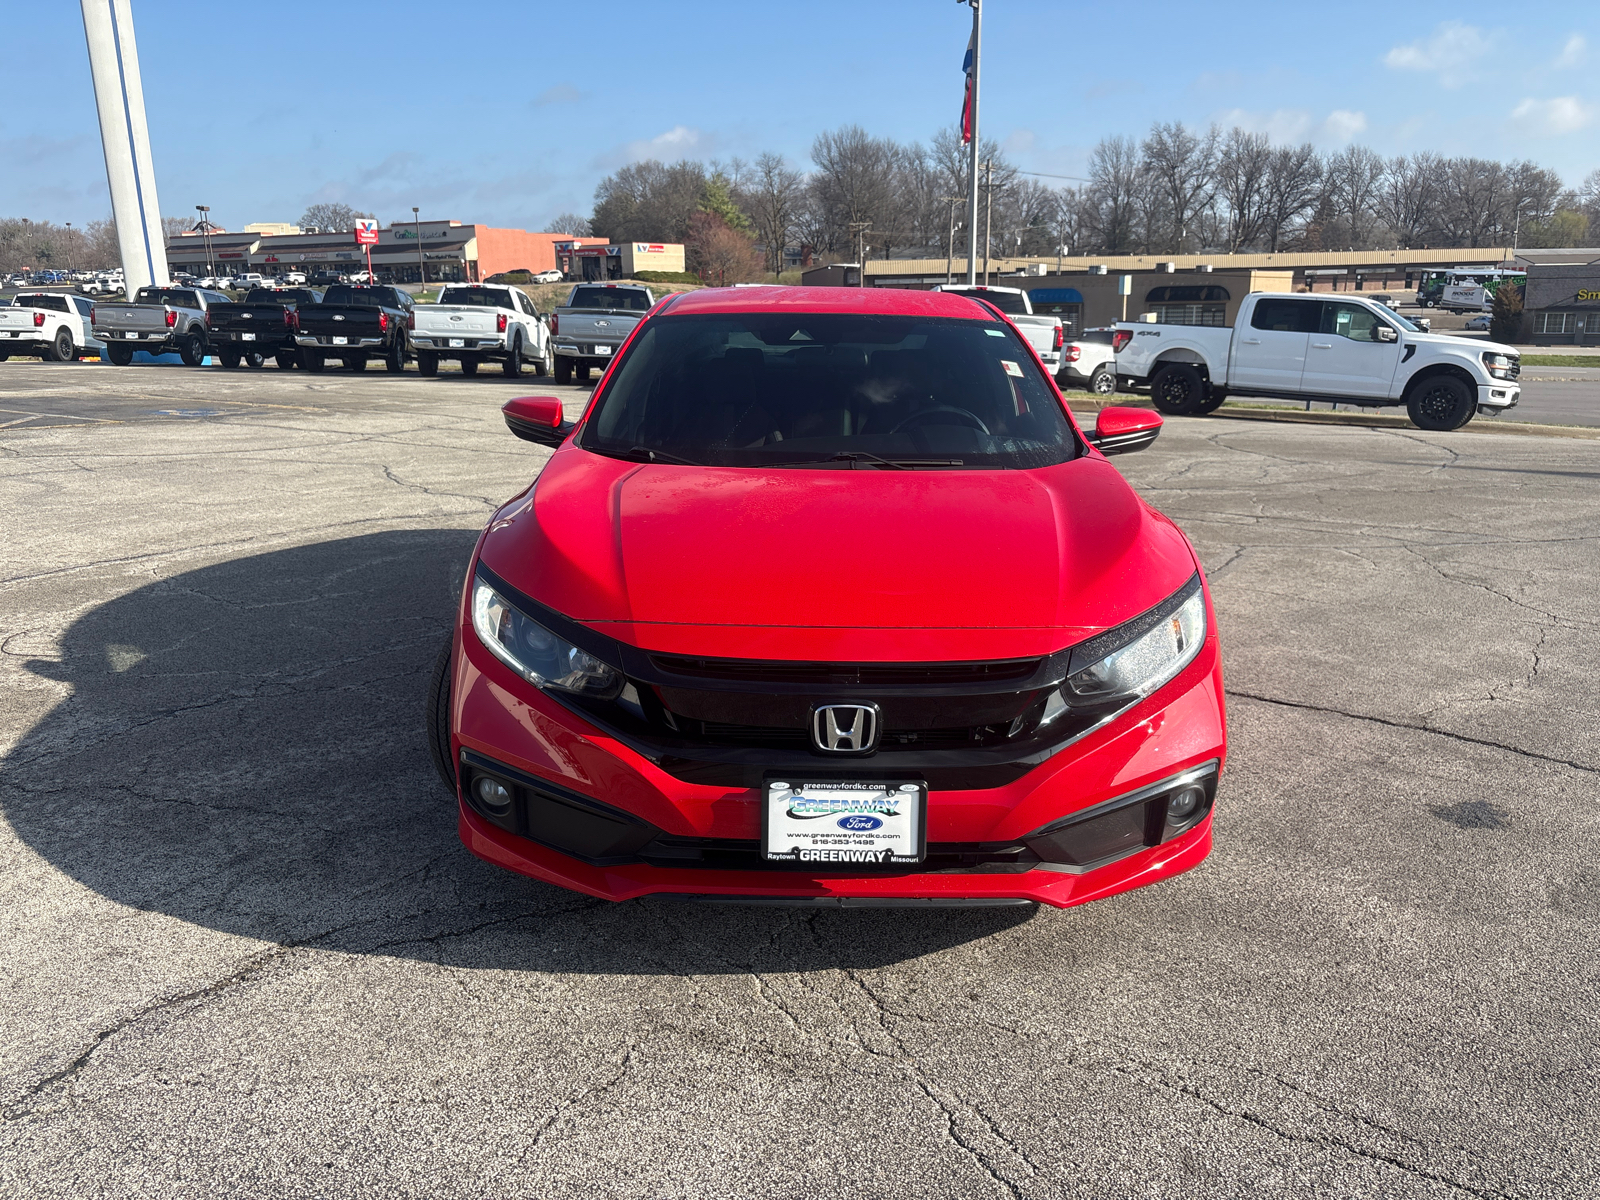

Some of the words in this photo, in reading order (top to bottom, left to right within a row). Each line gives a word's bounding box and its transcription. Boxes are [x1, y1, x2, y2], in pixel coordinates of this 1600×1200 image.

[1577, 288, 1600, 301] Sm
[789, 796, 899, 813] GREENWAY
[767, 853, 796, 861] Raytown
[800, 849, 886, 863] GREENWAY
